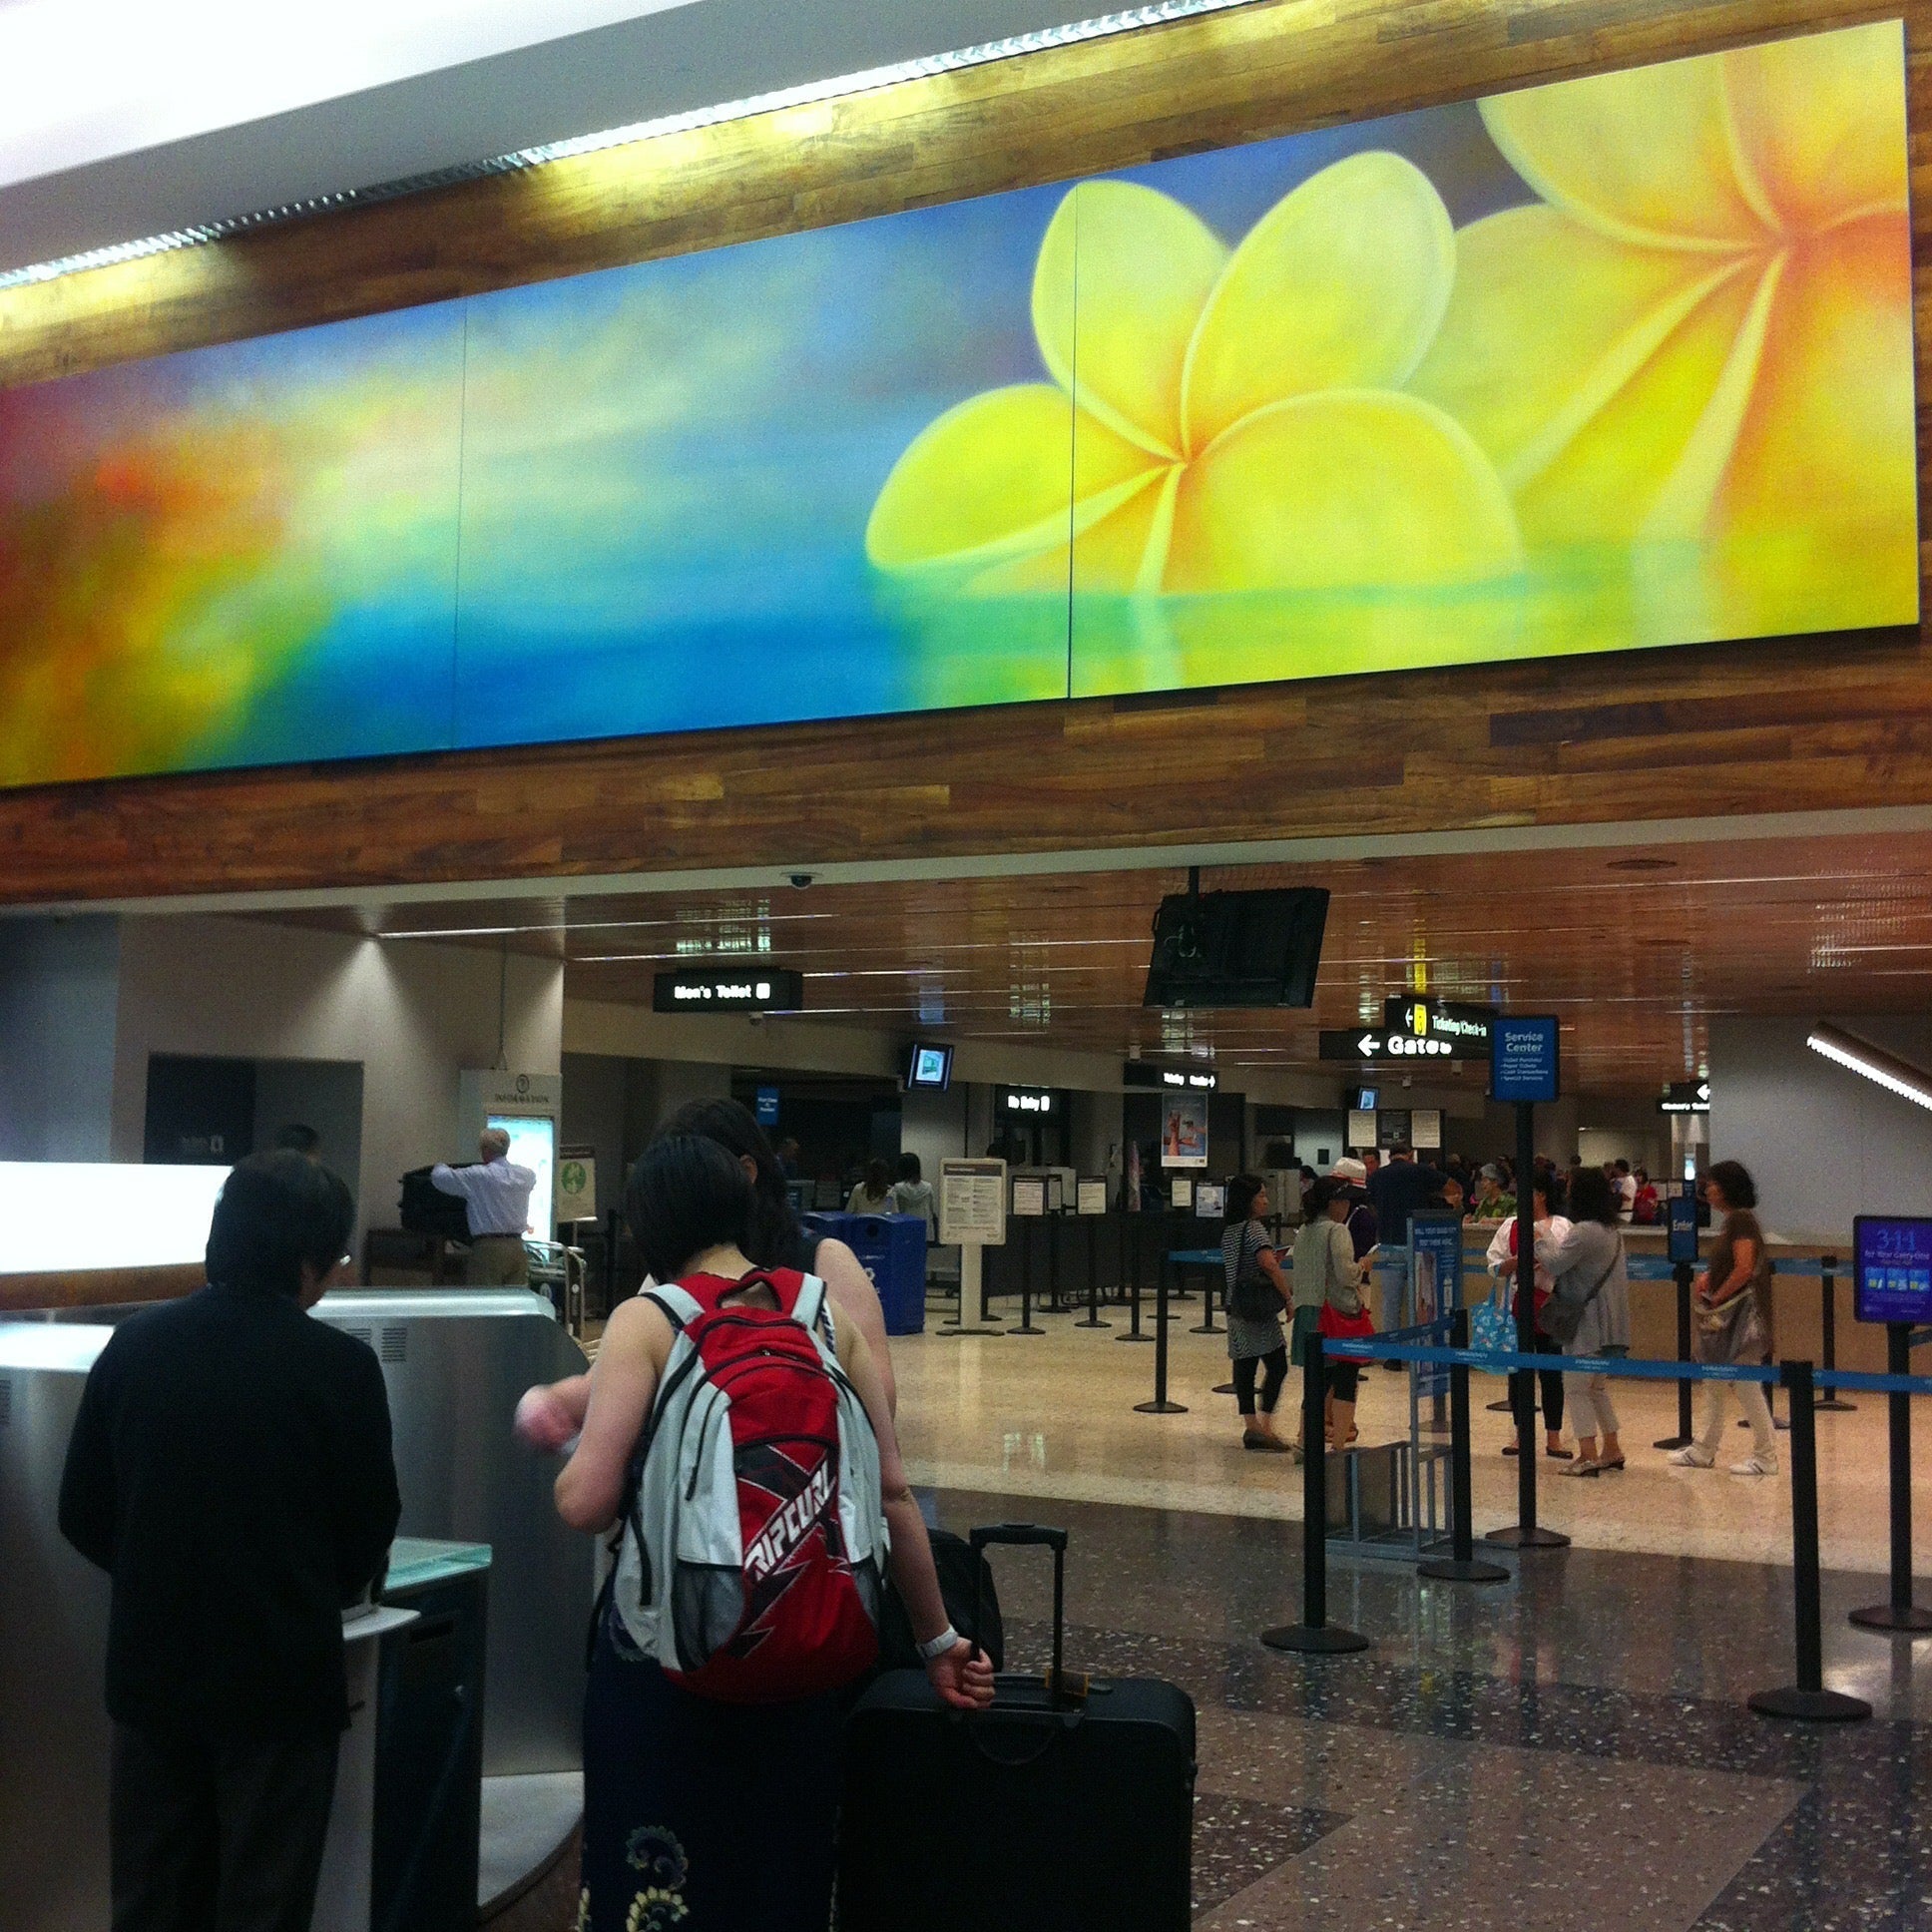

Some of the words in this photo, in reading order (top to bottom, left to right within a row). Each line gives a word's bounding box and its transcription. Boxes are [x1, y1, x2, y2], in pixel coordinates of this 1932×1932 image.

[674, 985, 712, 999] Men's
[716, 984, 752, 998] Toilet
[1505, 1031, 1544, 1042] Service
[1387, 1036, 1453, 1055] Gates
[1506, 1043, 1543, 1053] Center
[1673, 1219, 1693, 1231] Enter
